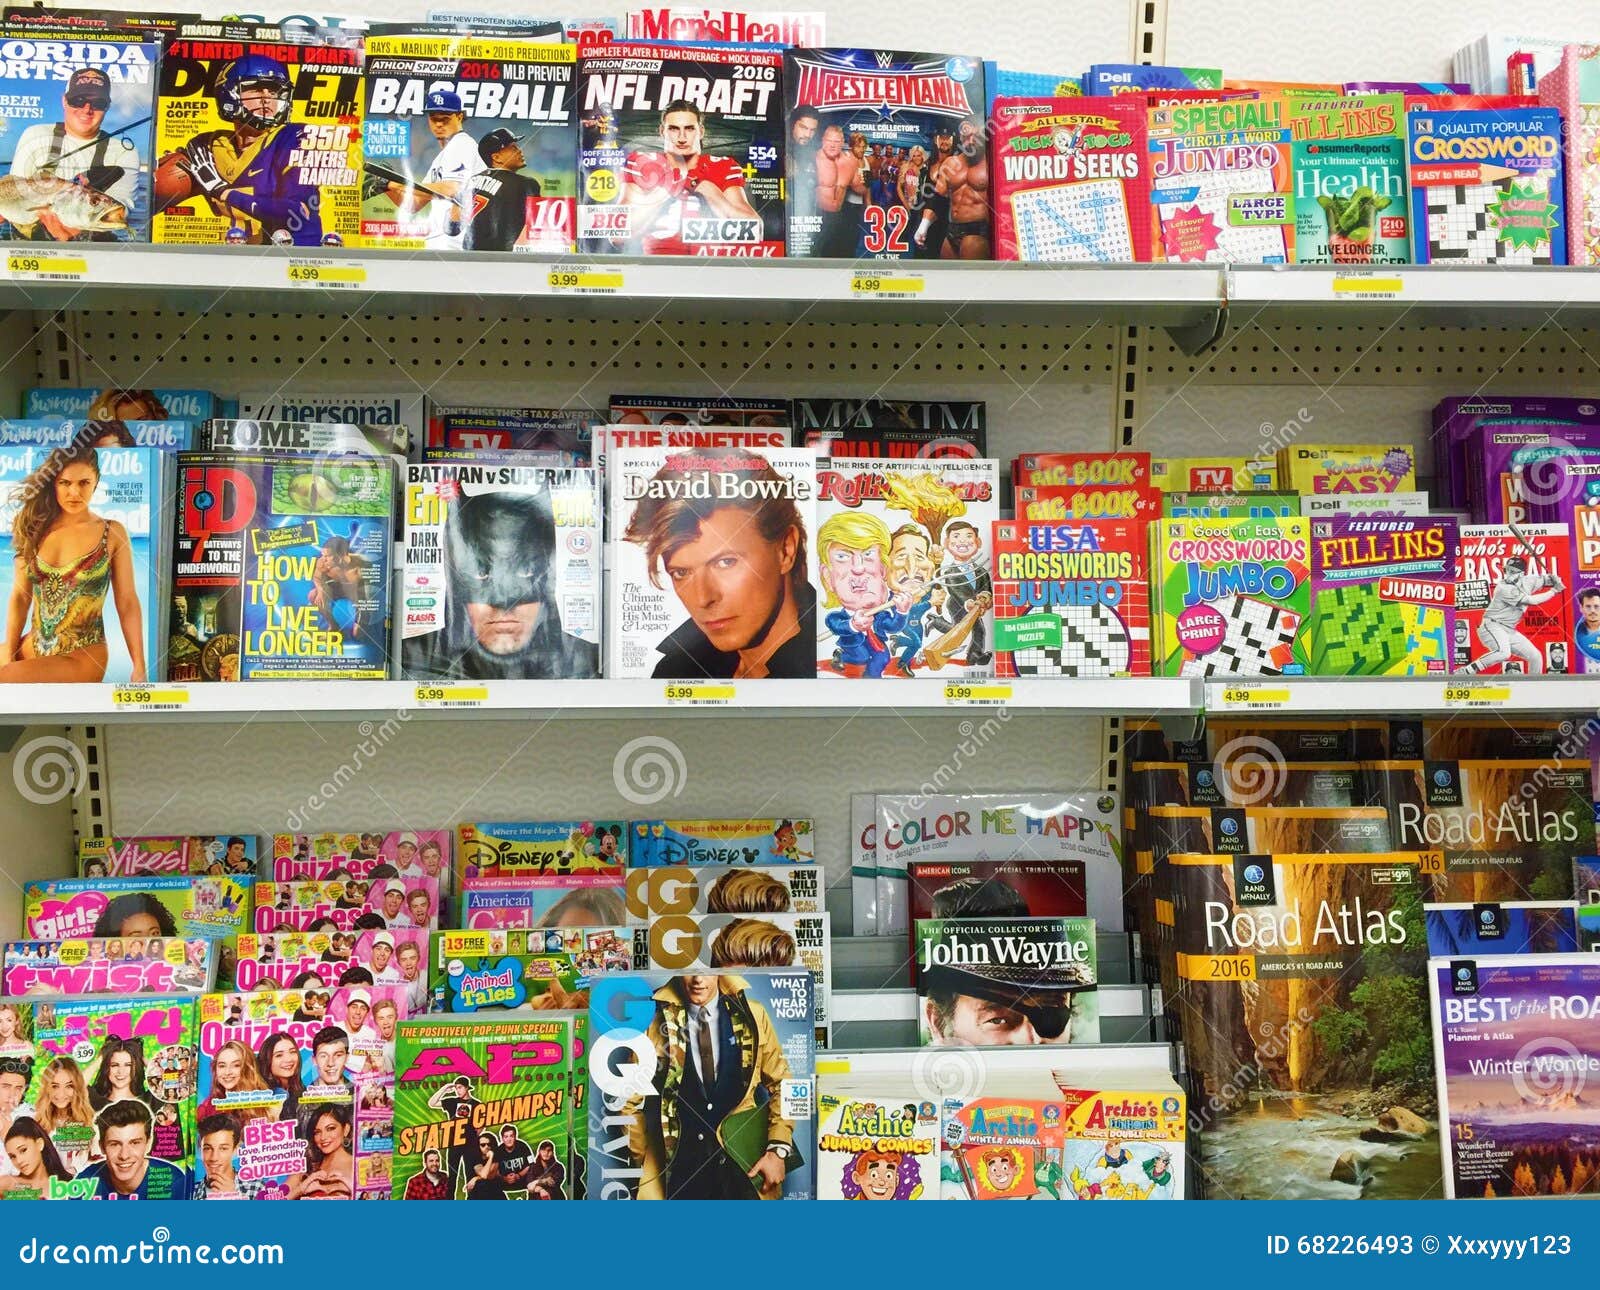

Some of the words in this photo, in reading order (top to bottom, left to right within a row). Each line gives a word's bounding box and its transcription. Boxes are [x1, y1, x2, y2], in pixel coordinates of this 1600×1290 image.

[473, 17, 506, 25] PROTEIN
[182, 25, 222, 37] STRATEGY
[256, 28, 280, 40] STATS
[301, 64, 319, 73] PRO
[320, 65, 364, 75] FOOTBALL
[372, 61, 415, 71] ATHLON
[416, 63, 455, 72] SPORTS
[585, 60, 623, 69] ATHLON
[624, 61, 660, 70] SPORTS
[461, 62, 500, 79] 2016
[503, 64, 525, 80] MLB
[527, 65, 571, 82] PREVIEW
[732, 66, 775, 81] 2016
[1100, 72, 1132, 83] Dell
[584, 73, 653, 111] NFL
[658, 75, 776, 116] DRAFT
[167, 101, 208, 110] JARED
[167, 110, 200, 118] GOFF
[1172, 101, 1281, 135] SPECIAL!
[849, 123, 876, 132] SPECIAL
[877, 124, 920, 133] COLLECTOR'S
[1439, 122, 1488, 137] QUALITY
[1492, 121, 1545, 134] POPULAR
[367, 145, 407, 155] YOUTH
[748, 146, 778, 161] 554
[1414, 135, 1558, 161] CROSSWORD
[288, 150, 347, 168] PLAYERS
[582, 158, 598, 166] QB
[599, 157, 626, 166] CROP
[1300, 157, 1322, 167] Your
[1323, 156, 1361, 166] Ultimate
[1362, 156, 1388, 165] Guide
[1390, 156, 1399, 165] to
[1004, 155, 1068, 181] WORD
[1073, 153, 1139, 180] SEEKS
[299, 167, 358, 186] RANKED!
[1417, 170, 1442, 180] EASY
[1444, 170, 1453, 179] to
[1454, 169, 1479, 179] READ
[1296, 166, 1403, 199] Health
[1233, 198, 1285, 209] LARGE
[1241, 209, 1285, 219] TYPE
[684, 220, 758, 242] SACK
[863, 206, 910, 253] 32
[11, 259, 40, 272] 4.99
[290, 269, 319, 280] 4.99
[551, 275, 578, 286] 3.99
[854, 279, 880, 290] 4.99
[213, 420, 312, 449] HOME
[1494, 434, 1548, 444] PennyPress
[100, 451, 144, 476] 2016
[833, 461, 850, 469] THE
[932, 463, 992, 471] INTELLIGENCE
[408, 465, 484, 485] BATMAN
[499, 467, 596, 487] SUPERMAN
[1196, 469, 1226, 485] TV
[623, 471, 711, 501] David
[718, 471, 811, 501] Bowie
[1348, 521, 1415, 532] FEATURED
[1463, 530, 1485, 538] OUR
[1521, 528, 1548, 536] YEAR
[410, 532, 438, 548] DARK
[1030, 525, 1101, 552] USA
[406, 548, 442, 564] KNIGHT
[1168, 539, 1306, 564] CROSSWORDS
[177, 562, 241, 574] UNDERWORLD
[258, 555, 316, 581] HOW
[998, 552, 1133, 580] CROSSWORDS
[247, 580, 280, 605] TO
[622, 582, 641, 593] The
[1009, 580, 1123, 607] JUMBO
[1381, 581, 1446, 601] JUMBO
[622, 593, 665, 602] Ultimate
[266, 606, 319, 631] LIVE
[622, 612, 641, 621] His
[642, 612, 672, 621] Music
[1177, 614, 1221, 630] LARGE
[1180, 627, 1221, 640] PRINT
[245, 631, 343, 657] LONGER
[116, 692, 151, 703] 13.99
[417, 689, 444, 700] 5.99
[667, 687, 693, 698] 5.99
[946, 688, 972, 698] 3.99
[1225, 691, 1250, 701] 4.99
[1446, 690, 1470, 700] 9.99
[1399, 799, 1486, 846] Road
[1495, 798, 1578, 843] Atlas
[884, 811, 971, 851] COLOR
[981, 808, 1016, 835] ME
[917, 866, 950, 875] AMERICAN
[951, 867, 971, 875] ICONS
[58, 882, 83, 891] Learn
[96, 882, 120, 890] draw
[121, 881, 153, 891] yummy
[155, 880, 189, 888] cookies!
[470, 894, 530, 908] American
[798, 919, 823, 928] NEW
[1203, 894, 1303, 949] Road
[1312, 896, 1407, 946] Atlas
[795, 929, 823, 939] WILD
[923, 927, 941, 935] THE
[943, 926, 986, 934] OFFICIAL
[988, 925, 1048, 933] COLLECTOR'S
[1051, 924, 1088, 932] EDITION
[797, 939, 823, 947] STYLE
[61, 948, 86, 958] FREE
[922, 934, 990, 972] John
[991, 936, 1089, 971] Wayne
[6, 960, 176, 997] twist
[461, 968, 513, 993] Animal
[770, 979, 807, 988] WHAT
[460, 986, 516, 1007] Tales
[790, 988, 807, 998] TO
[770, 998, 807, 1008] WEAR
[1445, 997, 1512, 1024] BEST
[1511, 1000, 1524, 1019] of
[1526, 1001, 1548, 1015] the
[1549, 995, 1600, 1021] ROA
[776, 1008, 807, 1018] NOW
[399, 1118, 468, 1156] STATE
[472, 1089, 563, 1129] CHAMPS!
[837, 1101, 916, 1136] Archie
[238, 1147, 260, 1156] Love,
[262, 1139, 308, 1154] Friendship
[818, 1136, 873, 1153] JUMBO
[876, 1137, 933, 1154] COMICS
[968, 1136, 1004, 1146] WINTER
[1006, 1137, 1041, 1146] ANNUAL
[1457, 1140, 1496, 1150] Wonderful
[1457, 1150, 1485, 1159] Winter
[1485, 1149, 1514, 1158] Retreats
[238, 1158, 307, 1181] QUIZZES!
